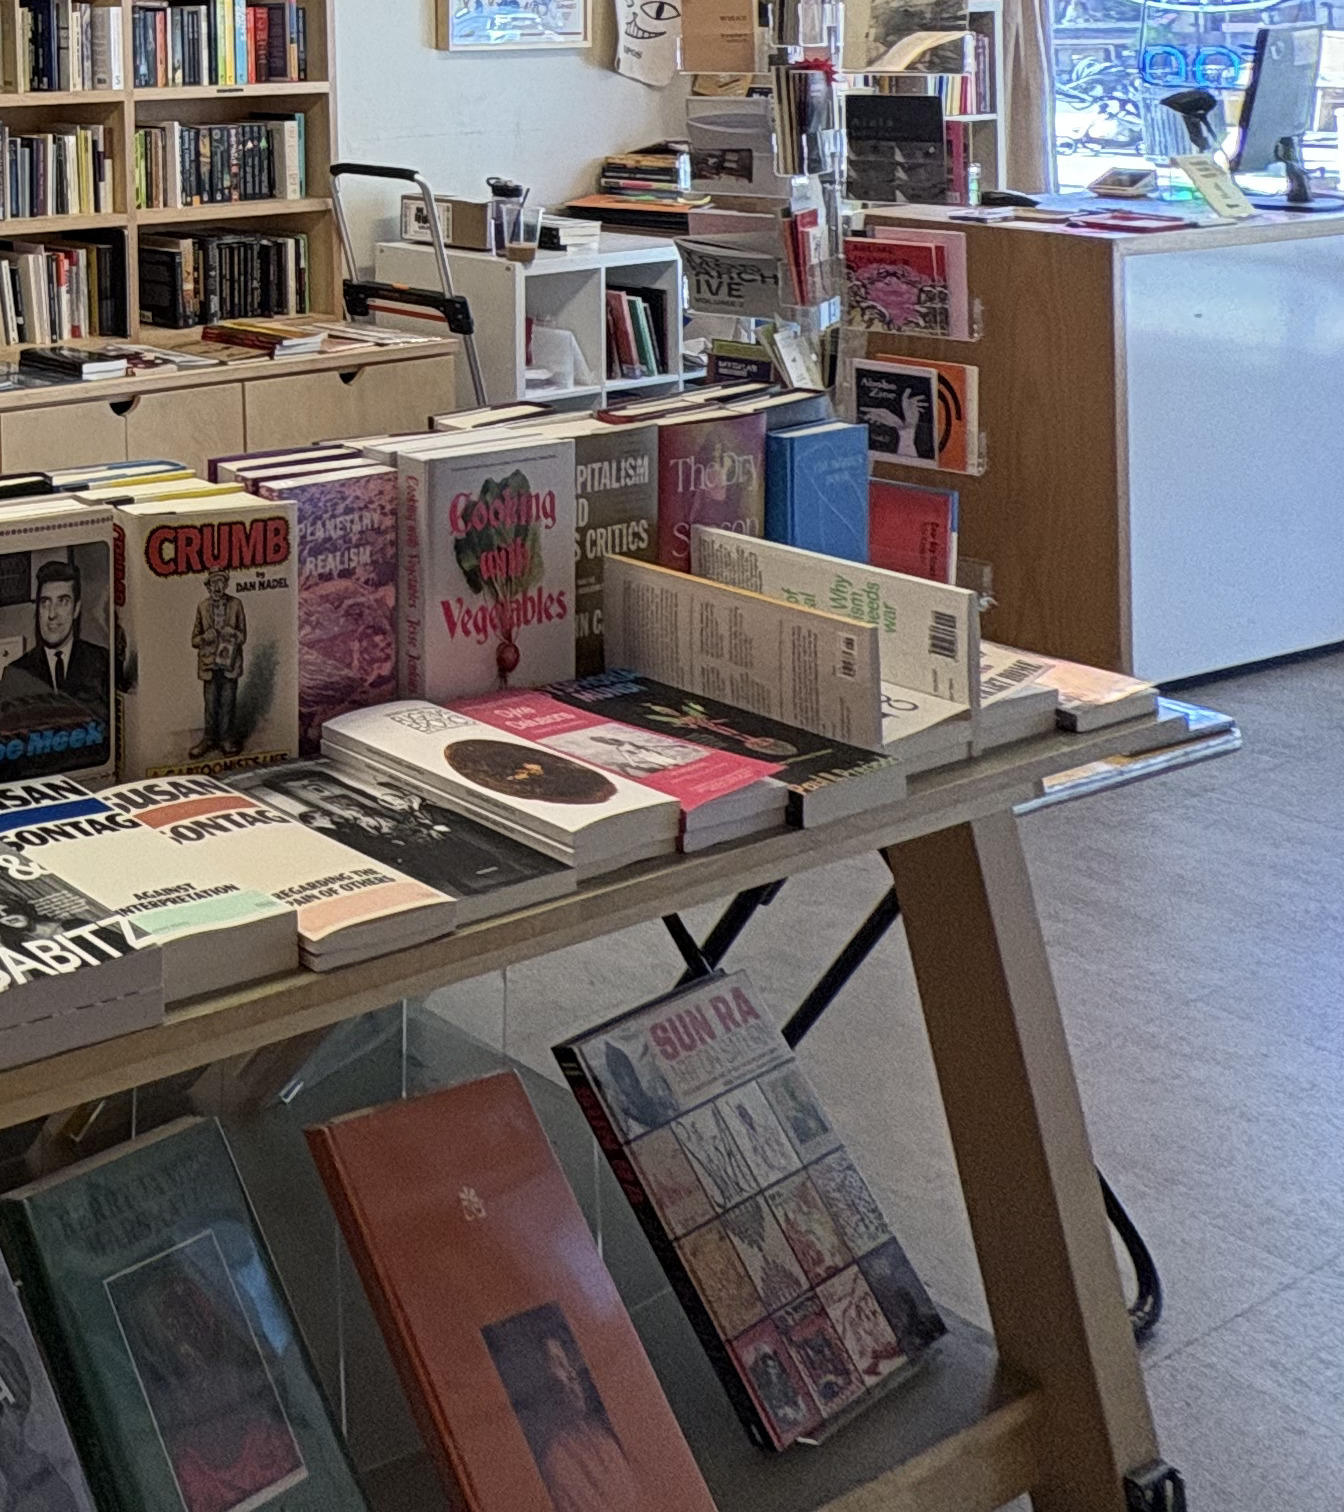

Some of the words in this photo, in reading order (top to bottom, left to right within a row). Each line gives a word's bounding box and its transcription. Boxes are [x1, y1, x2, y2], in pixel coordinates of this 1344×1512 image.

[670, 456, 723, 493] The
[298, 510, 382, 538] PLANETARY
[449, 490, 556, 536] Cooking
[146, 517, 291, 576] CRUMB
[587, 520, 649, 560] CRITICS
[306, 545, 372, 575] REALISM
[236, 581, 256, 593] DAN
[258, 577, 290, 591] NADEL
[830, 574, 852, 610] Why
[441, 586, 568, 646] Vegetables
[315, 887, 338, 901] OF
[339, 874, 396, 895] OTHERS
[353, 867, 383, 880] THE
[132, 882, 197, 902] AGAINST
[649, 1005, 718, 1062] SUN
[709, 986, 761, 1034] RA
